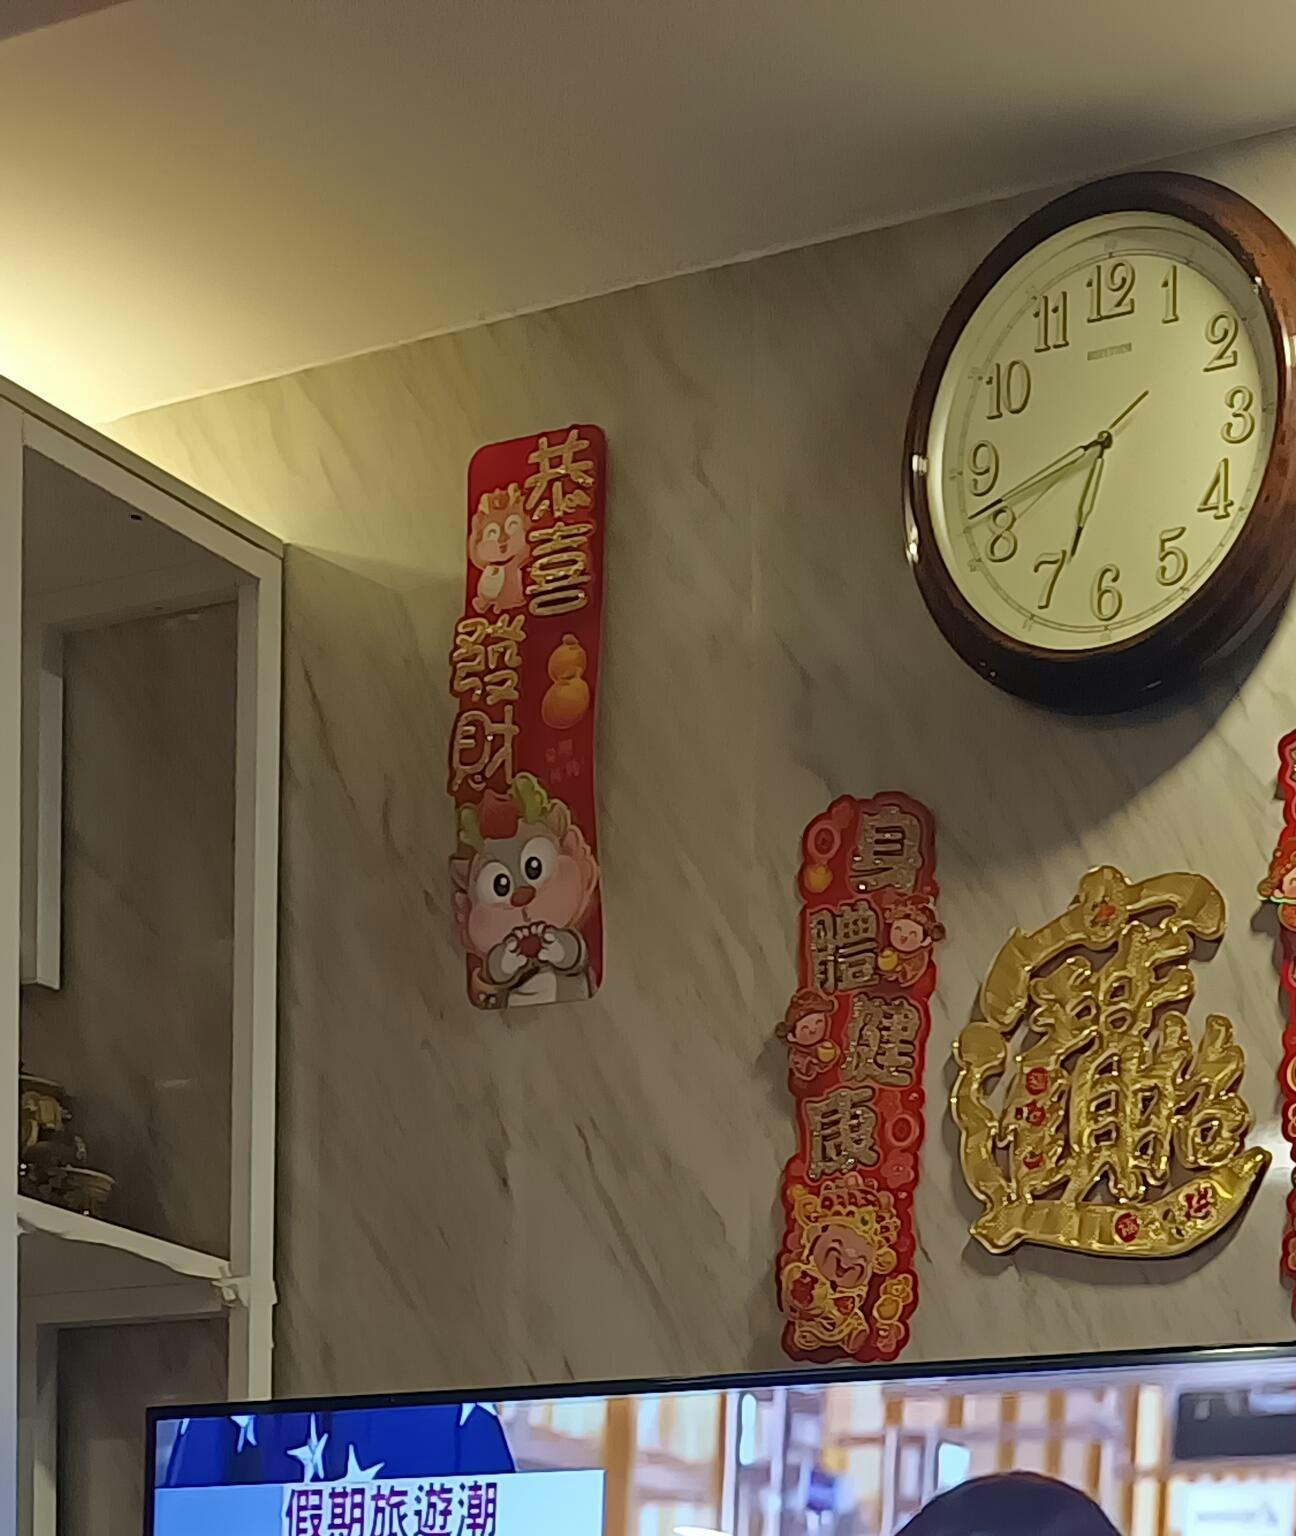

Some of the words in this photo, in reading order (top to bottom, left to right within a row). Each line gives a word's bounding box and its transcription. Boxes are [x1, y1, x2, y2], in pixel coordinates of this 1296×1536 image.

[1033, 291, 1070, 353] 11
[1086, 260, 1136, 324] 12
[1161, 264, 1179, 324] 1
[1203, 311, 1239, 372] 2
[985, 360, 1031, 420] 10
[1221, 386, 1256, 444] 3
[968, 440, 1000, 497] 9
[1197, 457, 1234, 520] 4
[524, 428, 597, 618] 恭喜
[988, 505, 1018, 563] 8
[1033, 549, 1067, 609] 7
[1155, 525, 1189, 587] 5
[1089, 563, 1123, 622] 6
[450, 612, 527, 792] 發財
